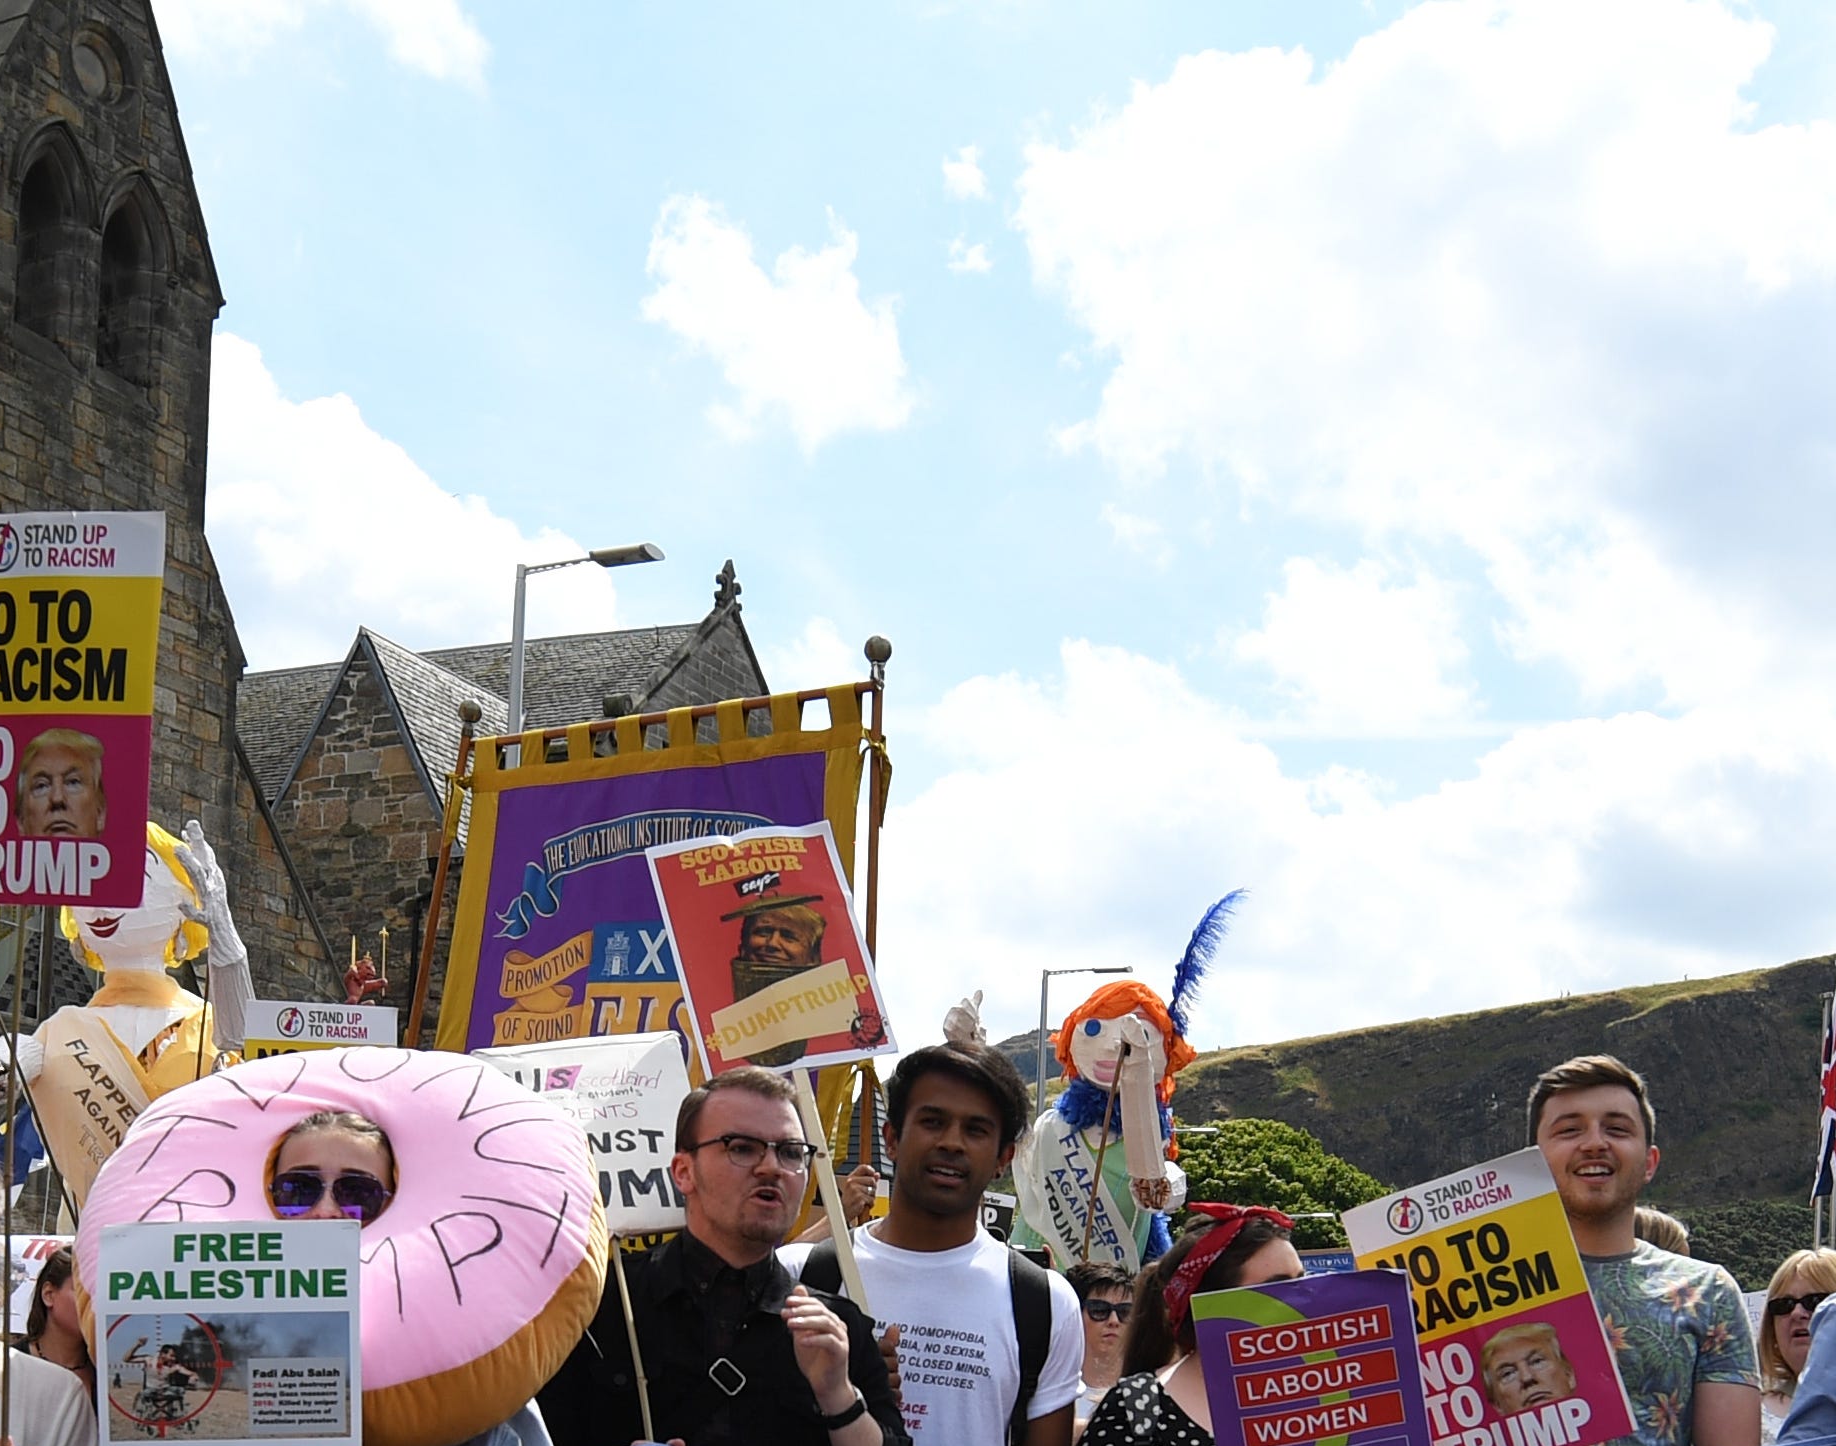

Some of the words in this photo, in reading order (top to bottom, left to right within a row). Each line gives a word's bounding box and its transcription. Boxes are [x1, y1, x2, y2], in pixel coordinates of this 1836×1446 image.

[24, 524, 78, 545] STAND
[83, 525, 108, 545] UP
[24, 549, 43, 568] TO
[47, 547, 116, 568] RACISM
[29, 589, 93, 645] TO
[543, 843, 567, 875] THE
[567, 826, 633, 866] EDUCATIONAL
[678, 836, 809, 871] SCOTTISH
[695, 854, 804, 888] LABOUR
[740, 872, 780, 895] says
[503, 941, 586, 993] PROMOTION
[308, 1010, 344, 1025] STAND
[346, 1012, 363, 1025] UP
[502, 1016, 521, 1040] OF
[523, 1013, 573, 1042] SOUND
[703, 974, 870, 1053] #DUMPTRUMP
[308, 1024, 324, 1038] TO
[326, 1026, 368, 1040] RACISM
[64, 1038, 141, 1127] FLAPPE
[72, 1087, 123, 1149] AGAIN
[588, 1128, 665, 1154] NST
[1423, 1179, 1474, 1208] STAND
[1475, 1171, 1499, 1191] UP
[1426, 1207, 1452, 1224] TO
[1452, 1184, 1514, 1217] RACISM
[173, 1232, 284, 1263] FREE
[1446, 1221, 1511, 1273] TO
[108, 1268, 348, 1301] PALESTINE
[910, 1325, 988, 1347] HOMOPHOBIA,
[1238, 1313, 1380, 1358] SCOTTISH
[908, 1356, 954, 1371] CLOSED
[955, 1361, 993, 1379] MINDS,
[924, 1343, 942, 1354] NO
[943, 1346, 987, 1363] SEXISM,
[1421, 1342, 1475, 1395] NO
[252, 1368, 278, 1378] Fadi
[280, 1368, 304, 1378] Abu
[307, 1367, 341, 1377] Salah
[903, 1371, 922, 1384] NO
[922, 1374, 976, 1391] EXCUSES.
[1246, 1361, 1364, 1401] LABOUR
[898, 1401, 929, 1415] EACE.
[1253, 1403, 1368, 1443] WOMEN
[1426, 1385, 1484, 1435] TO
